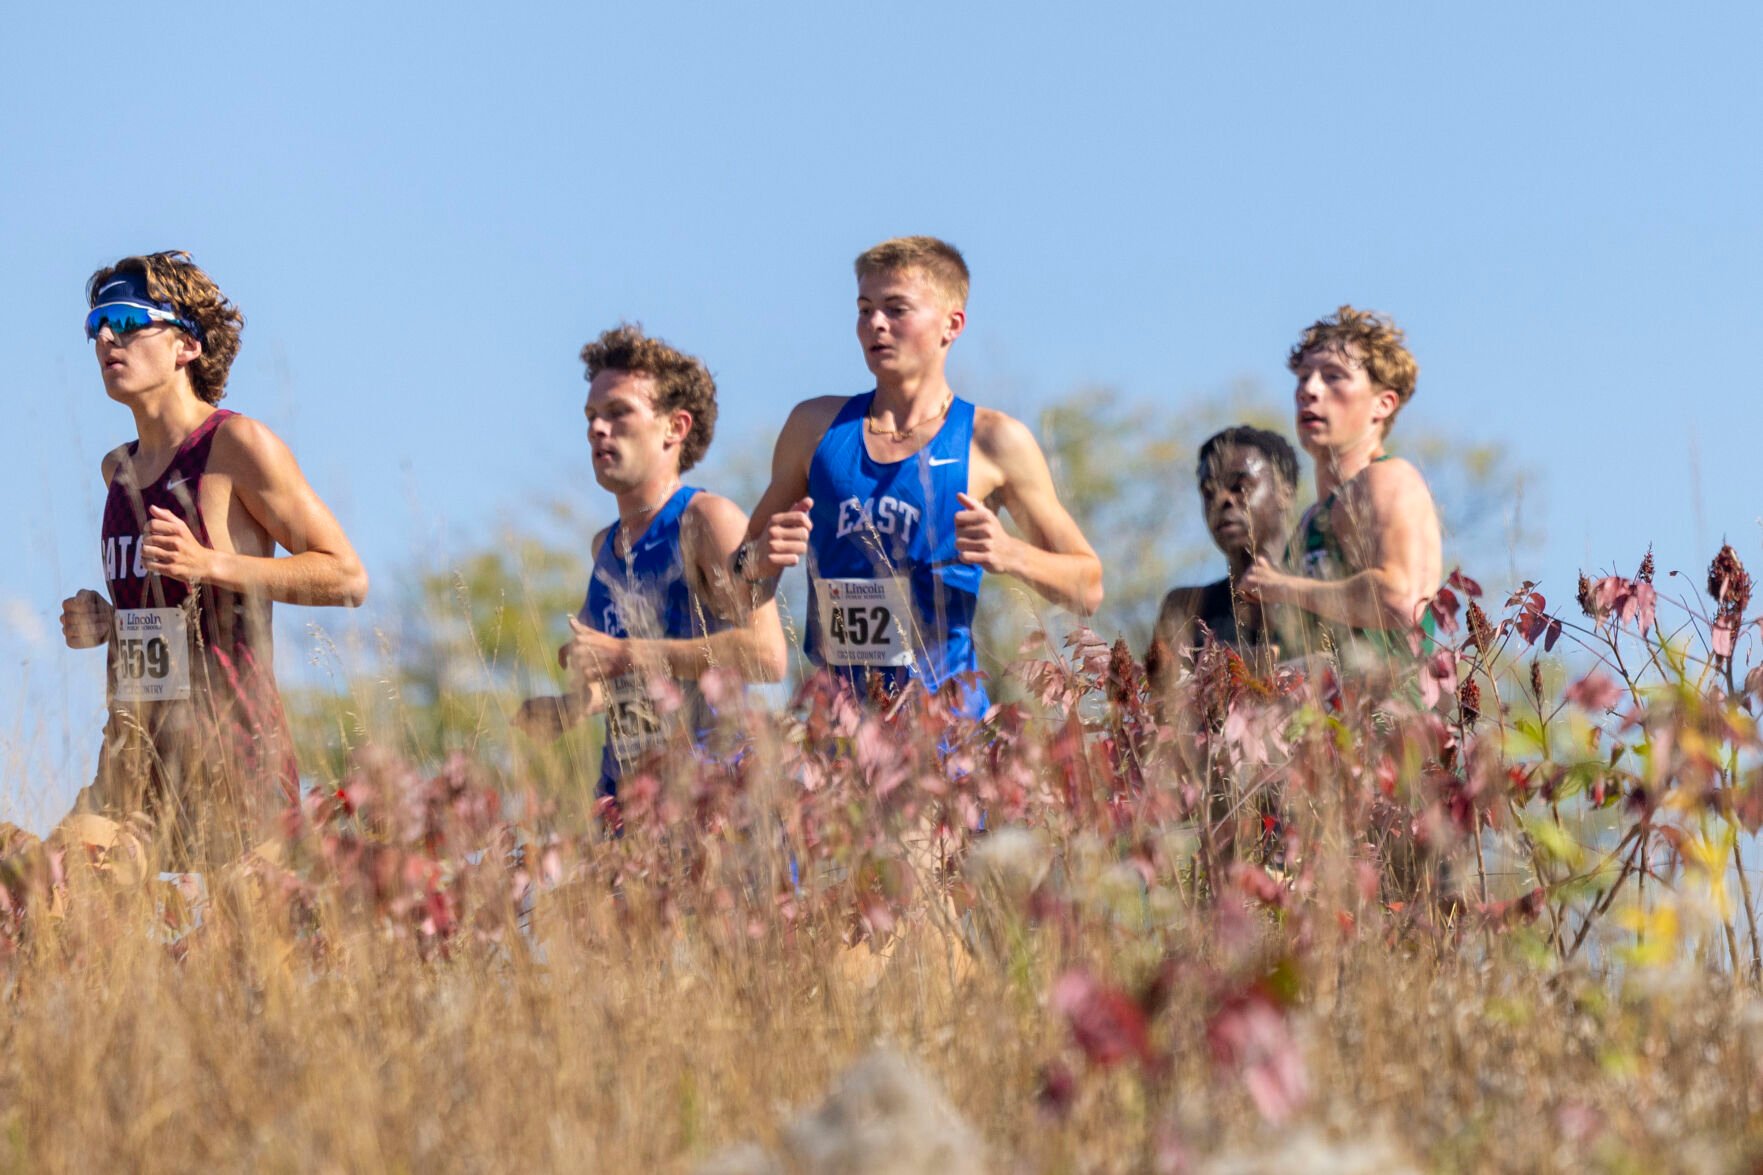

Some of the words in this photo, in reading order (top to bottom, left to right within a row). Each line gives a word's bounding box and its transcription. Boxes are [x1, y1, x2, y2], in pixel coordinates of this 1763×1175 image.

[836, 496, 920, 544] EAST
[845, 582, 885, 594] Lincoln
[127, 612, 162, 625] Lincoln
[830, 606, 890, 645] 452
